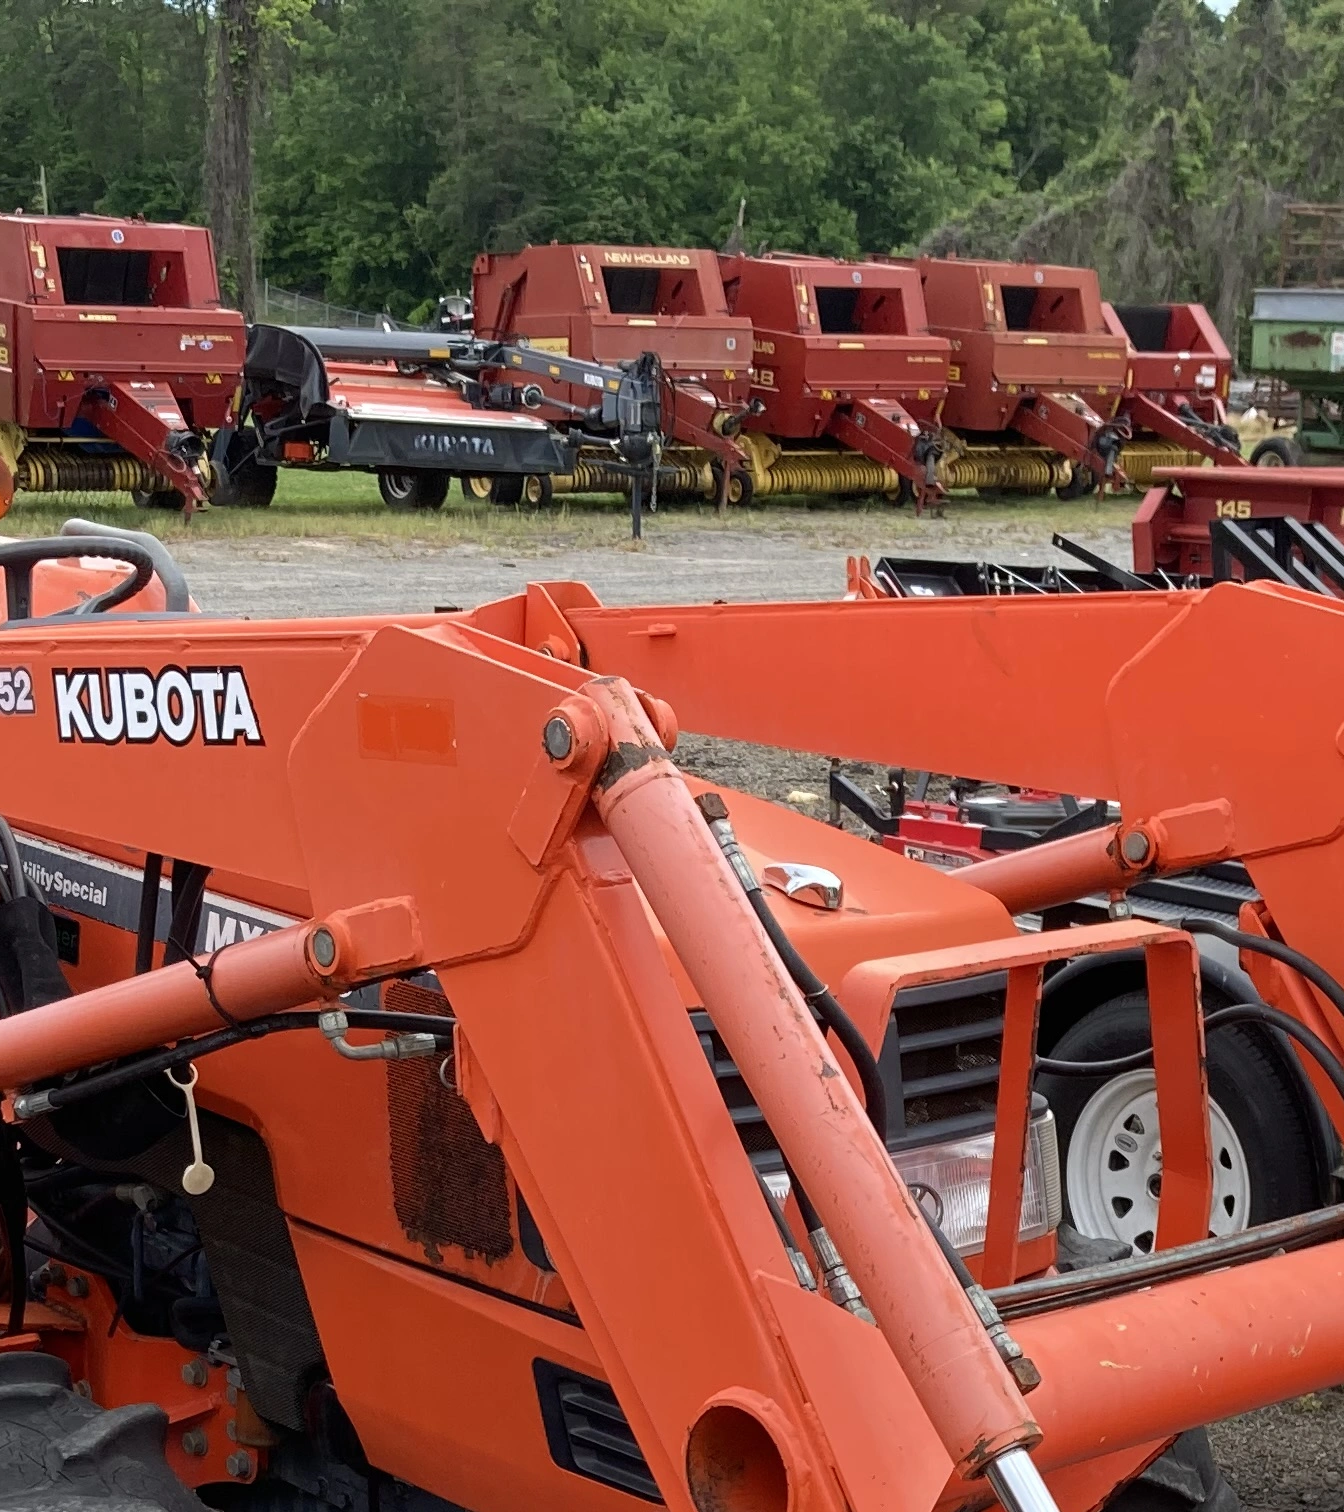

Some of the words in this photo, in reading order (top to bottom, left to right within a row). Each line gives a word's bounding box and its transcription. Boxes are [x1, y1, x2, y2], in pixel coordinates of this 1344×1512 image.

[604, 252, 632, 263] NEW
[634, 253, 690, 266] HOLLAND
[751, 368, 774, 386] 48
[1215, 499, 1252, 519] 145
[53, 669, 261, 742] KUBOTA
[22, 861, 108, 906] tilitySpecial
